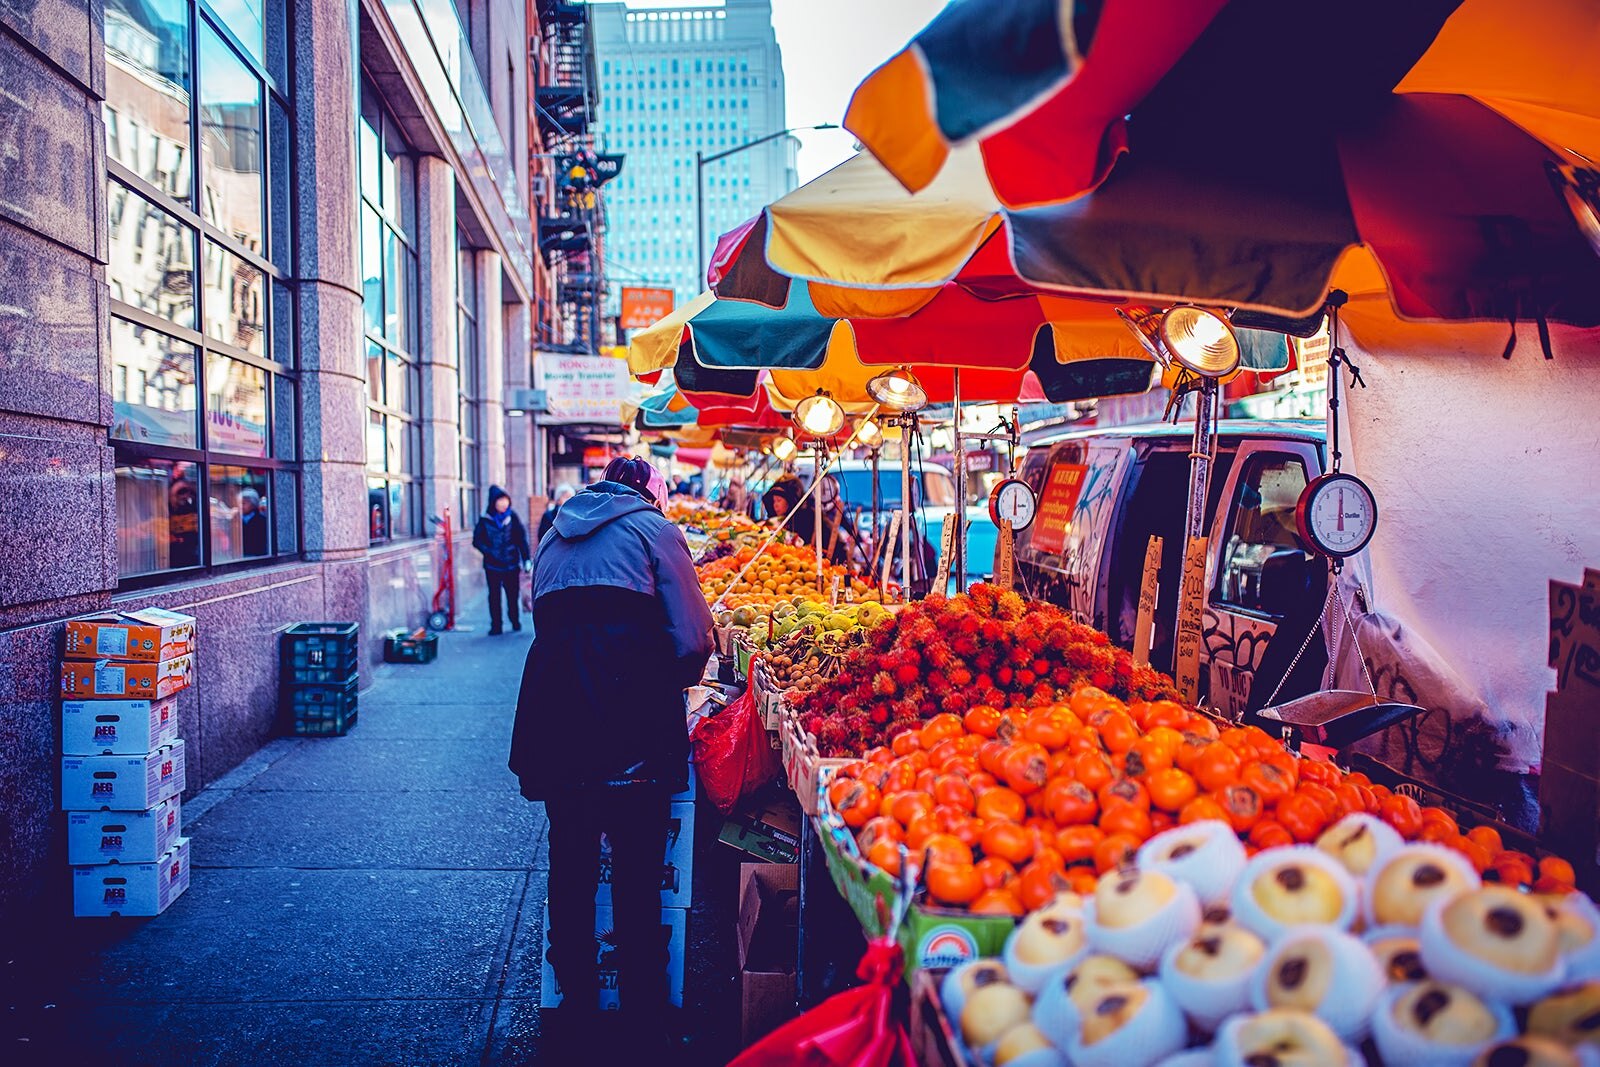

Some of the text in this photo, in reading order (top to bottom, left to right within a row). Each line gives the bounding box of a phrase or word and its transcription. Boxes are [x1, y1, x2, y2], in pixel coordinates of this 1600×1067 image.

[544, 371, 573, 381] Money
[94, 725, 116, 737] AEG
[92, 783, 113, 794] AEG
